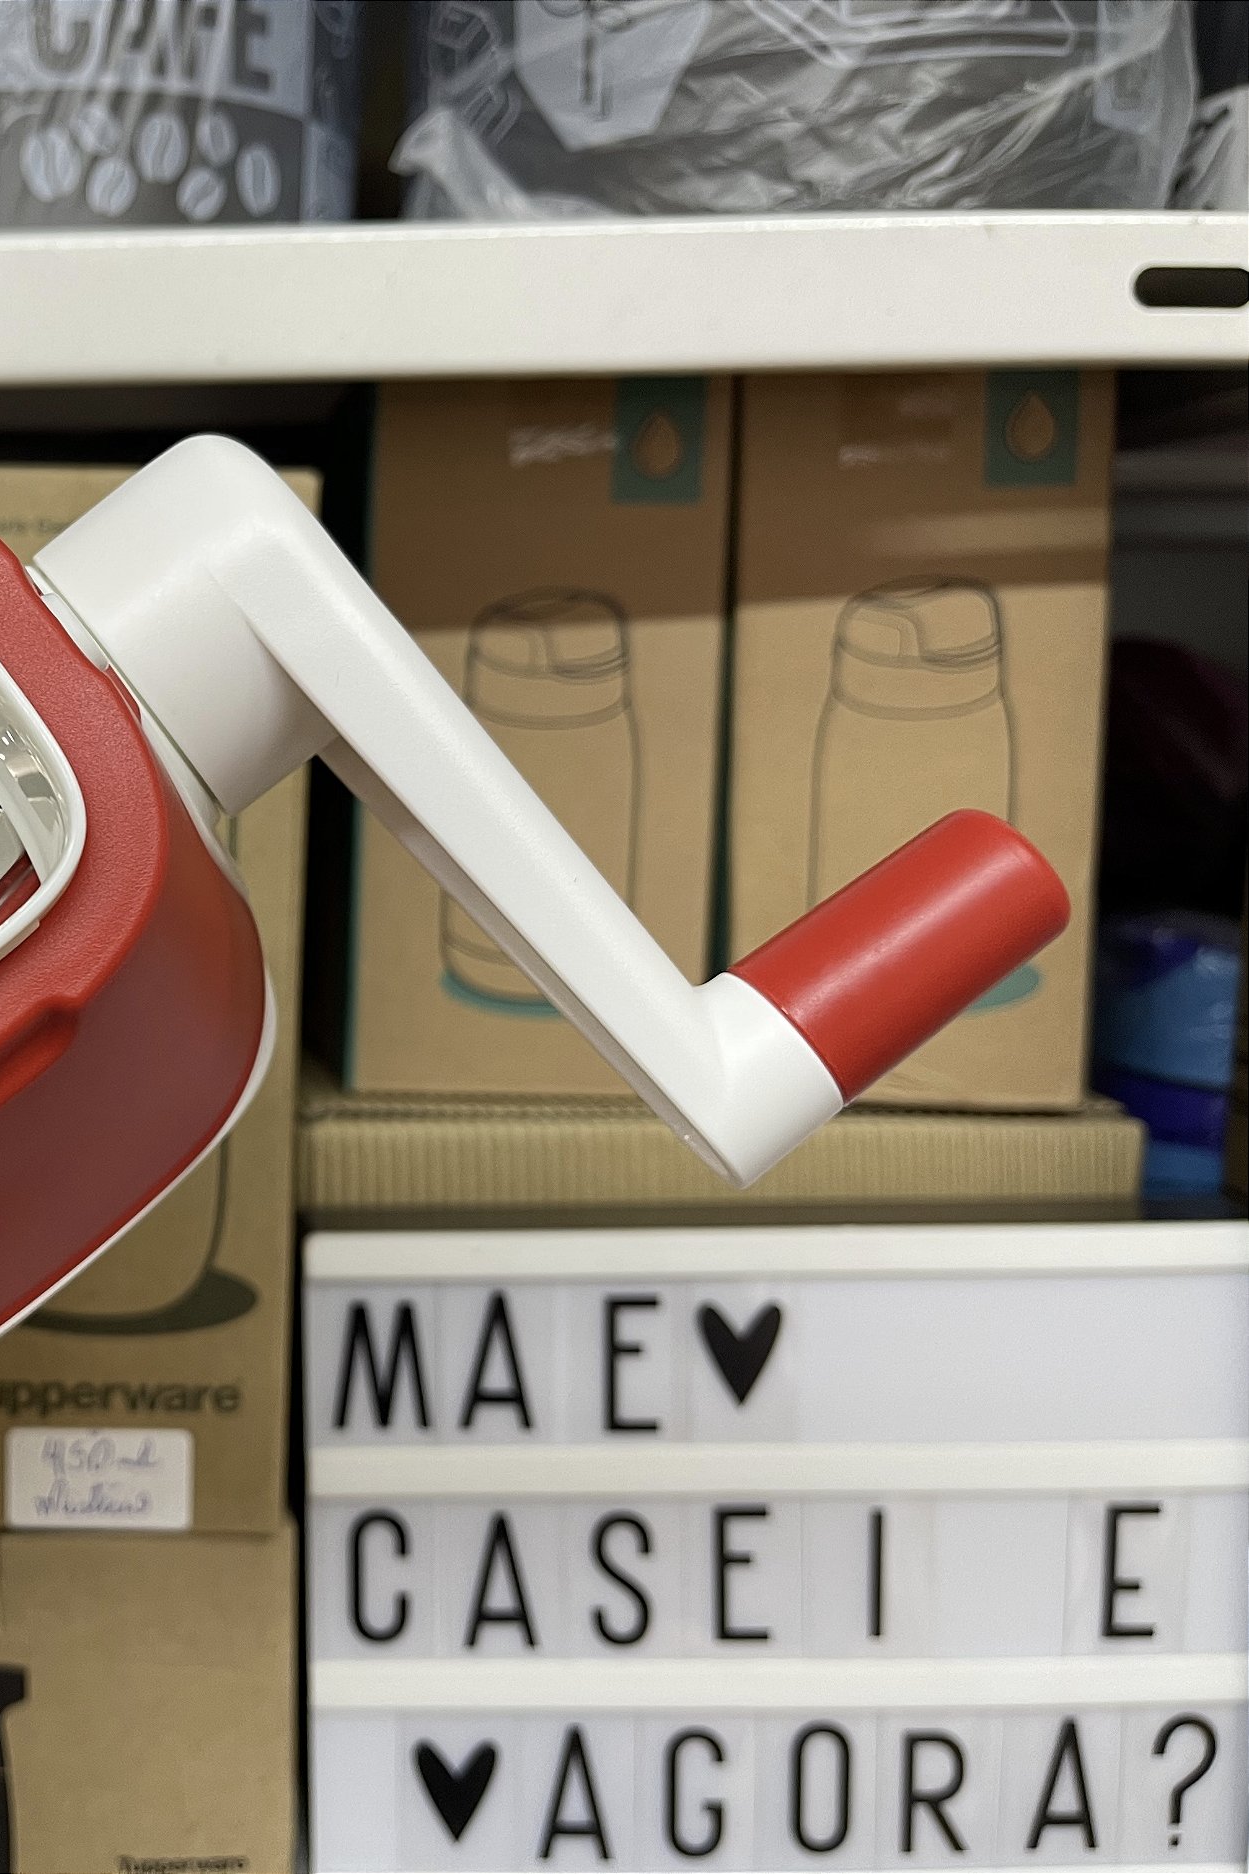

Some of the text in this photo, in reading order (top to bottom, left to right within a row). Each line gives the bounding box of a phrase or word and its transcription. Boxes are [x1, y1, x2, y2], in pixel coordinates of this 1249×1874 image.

[331, 1289, 661, 1435] MAE
[345, 1502, 1163, 1650] CASEI E
[538, 1713, 1219, 1863] AGORA?
